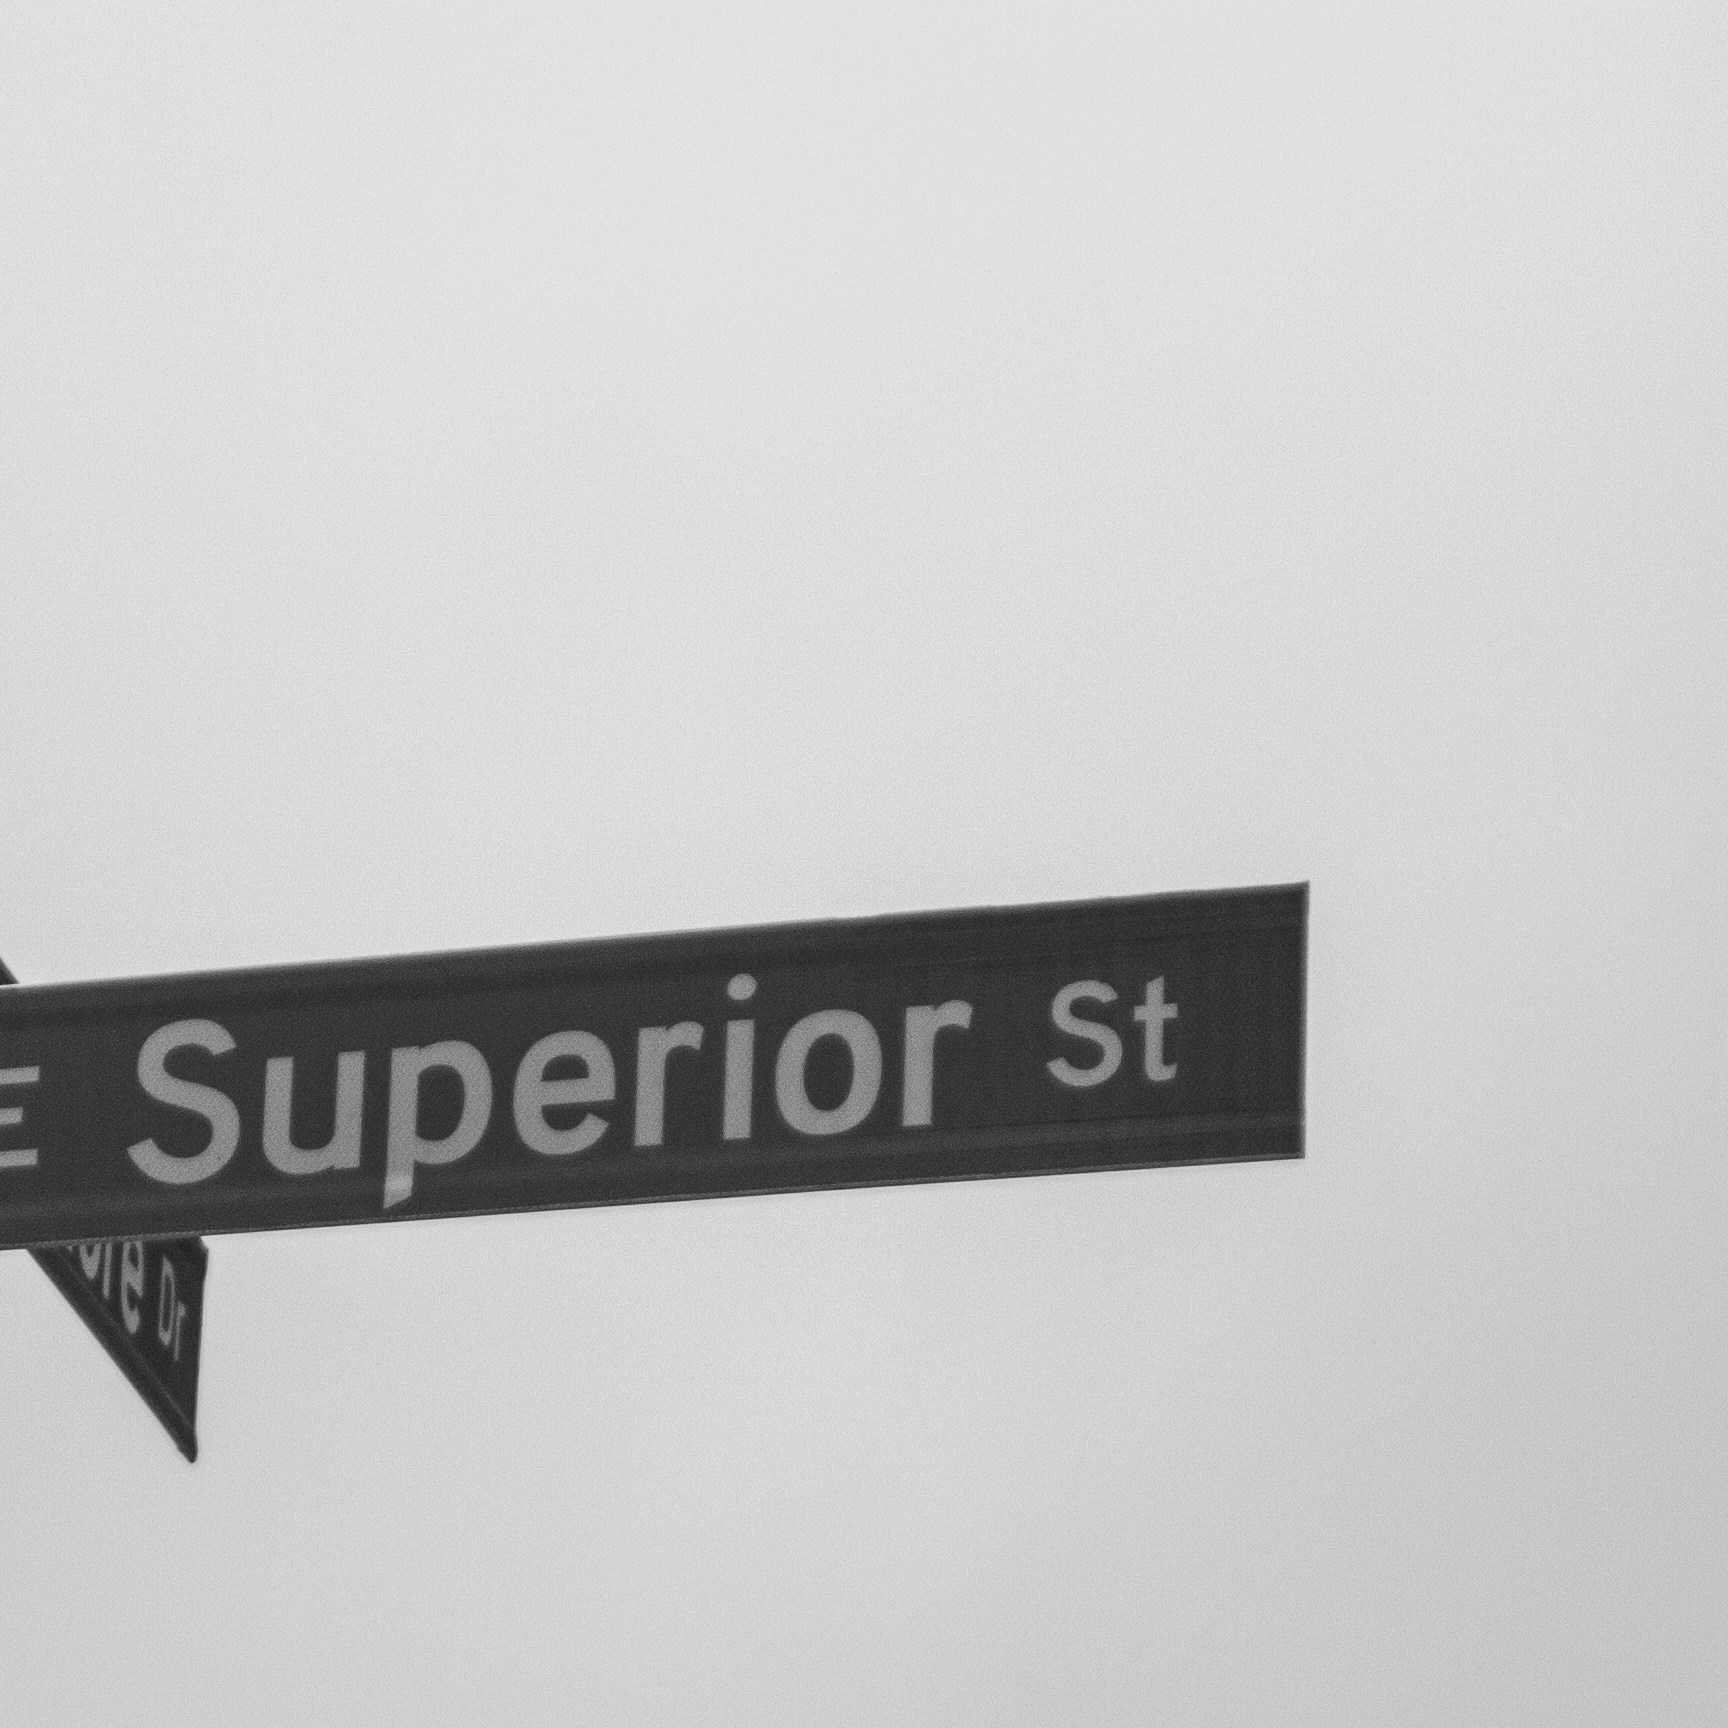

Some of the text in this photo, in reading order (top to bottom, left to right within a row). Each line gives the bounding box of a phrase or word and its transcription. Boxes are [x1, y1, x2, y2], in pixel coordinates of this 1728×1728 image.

[126, 972, 974, 1210] Superior
[1046, 974, 1179, 1088] St
[157, 1254, 188, 1363] Dr
